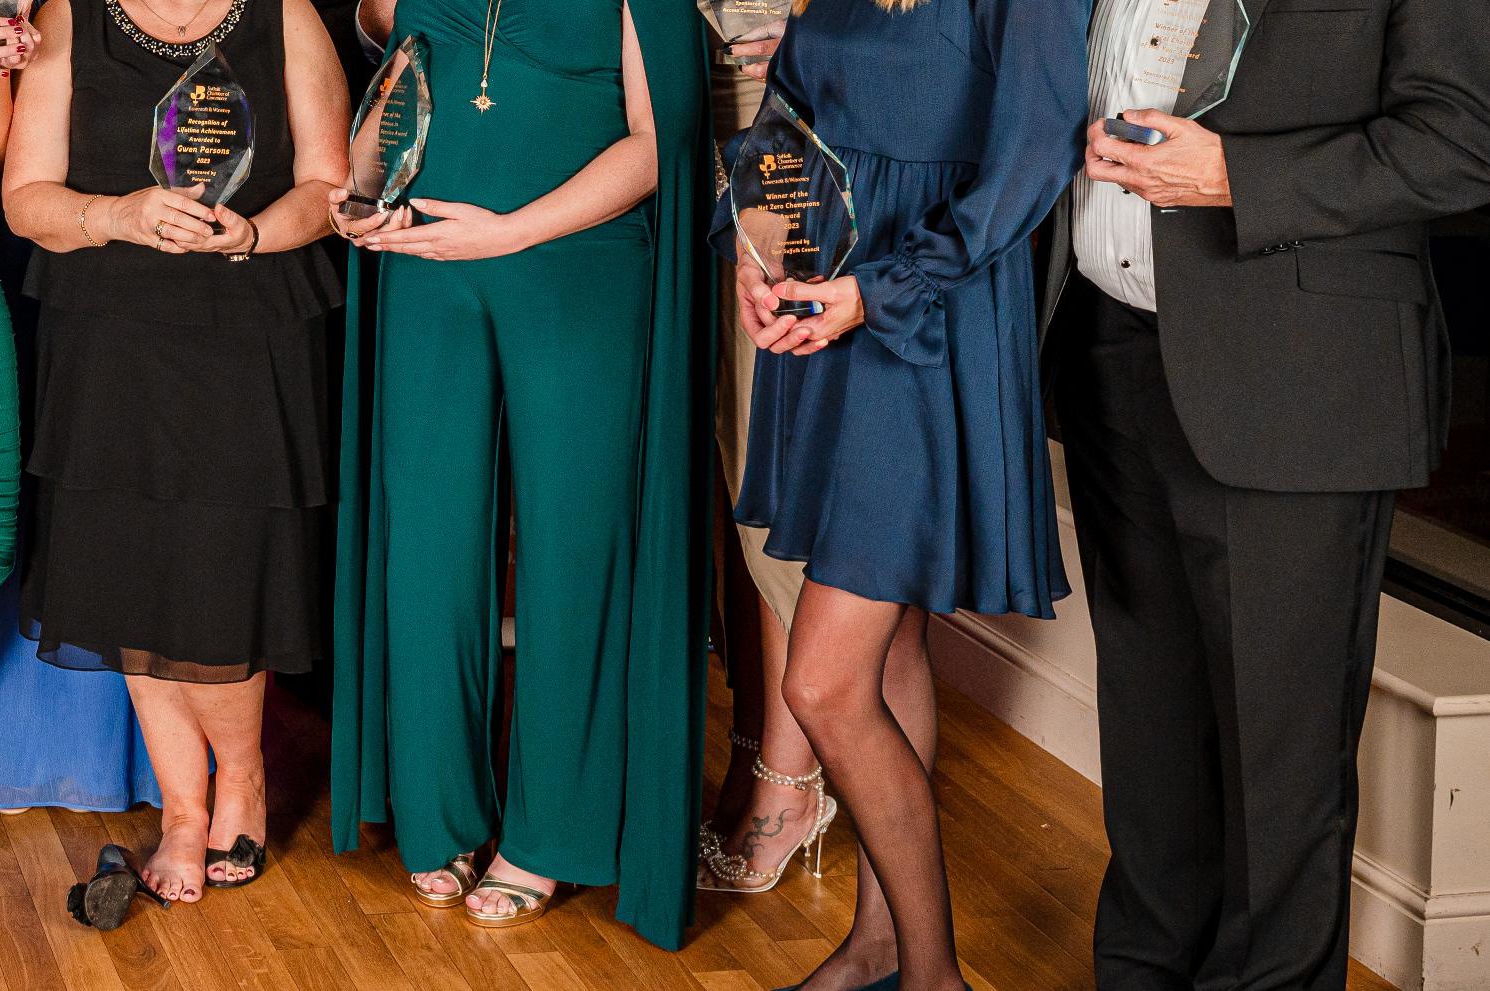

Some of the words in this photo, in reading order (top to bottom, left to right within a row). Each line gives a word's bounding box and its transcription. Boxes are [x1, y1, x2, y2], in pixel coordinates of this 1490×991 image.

[188, 118, 220, 126] Recognition
[177, 144, 198, 153] Gwen
[200, 145, 230, 155] Parsons
[789, 191, 796, 199] of
[797, 190, 809, 198] the
[757, 204, 769, 212] Net
[785, 200, 820, 208] Champions
